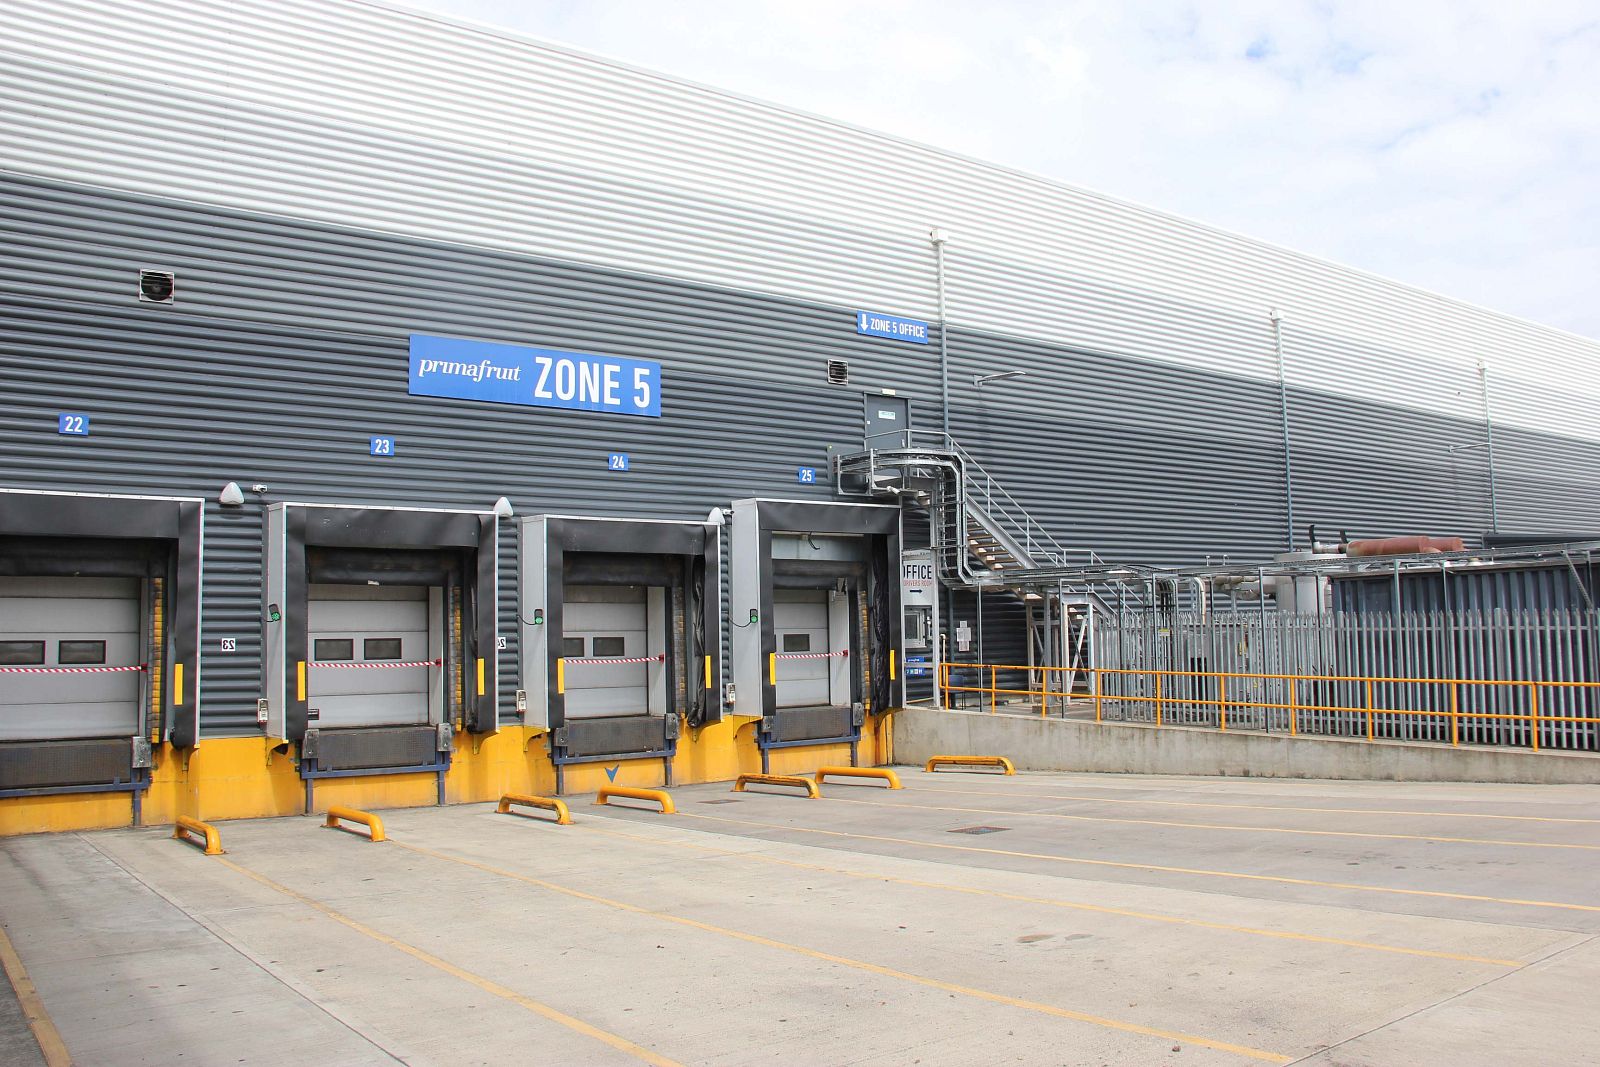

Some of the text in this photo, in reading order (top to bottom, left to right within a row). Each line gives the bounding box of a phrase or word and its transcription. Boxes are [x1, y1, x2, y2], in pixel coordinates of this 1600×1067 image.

[870, 318, 925, 338] ZONE 5 OFFICE
[418, 355, 651, 408] primafruit ZONE 5
[64, 415, 83, 433] 22
[374, 438, 390, 454] 23
[612, 455, 625, 469] 24
[801, 469, 812, 482] 25
